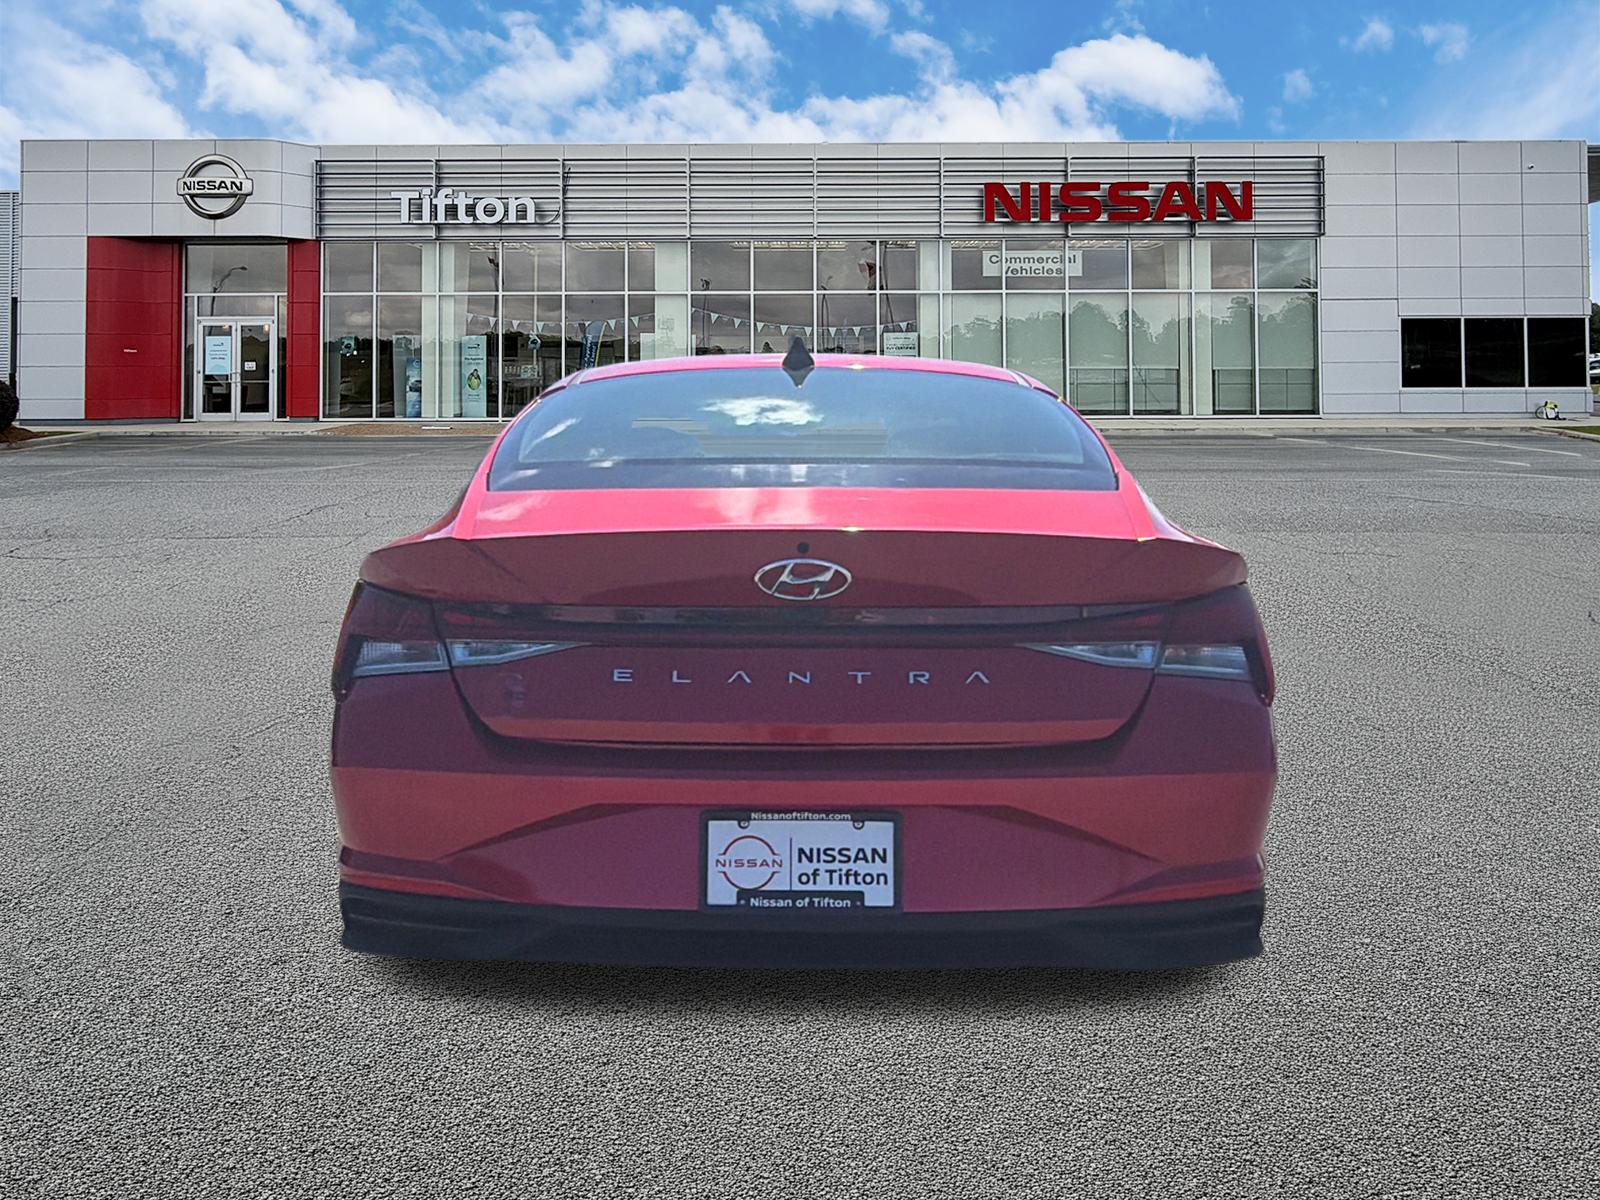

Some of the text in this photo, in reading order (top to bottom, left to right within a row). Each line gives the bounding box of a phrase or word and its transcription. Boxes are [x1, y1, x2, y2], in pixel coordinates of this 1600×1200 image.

[182, 180, 243, 192] NISSAN
[390, 187, 537, 224] Tifton
[983, 180, 1254, 222] NISSAN
[612, 668, 991, 685] ELANTRA
[751, 811, 851, 821] Nissanoftifton.com
[715, 858, 783, 868] NISSAN
[797, 847, 887, 864] NISSAN
[797, 868, 888, 886] of Tifton
[750, 897, 851, 908] Nissan of Tifton
